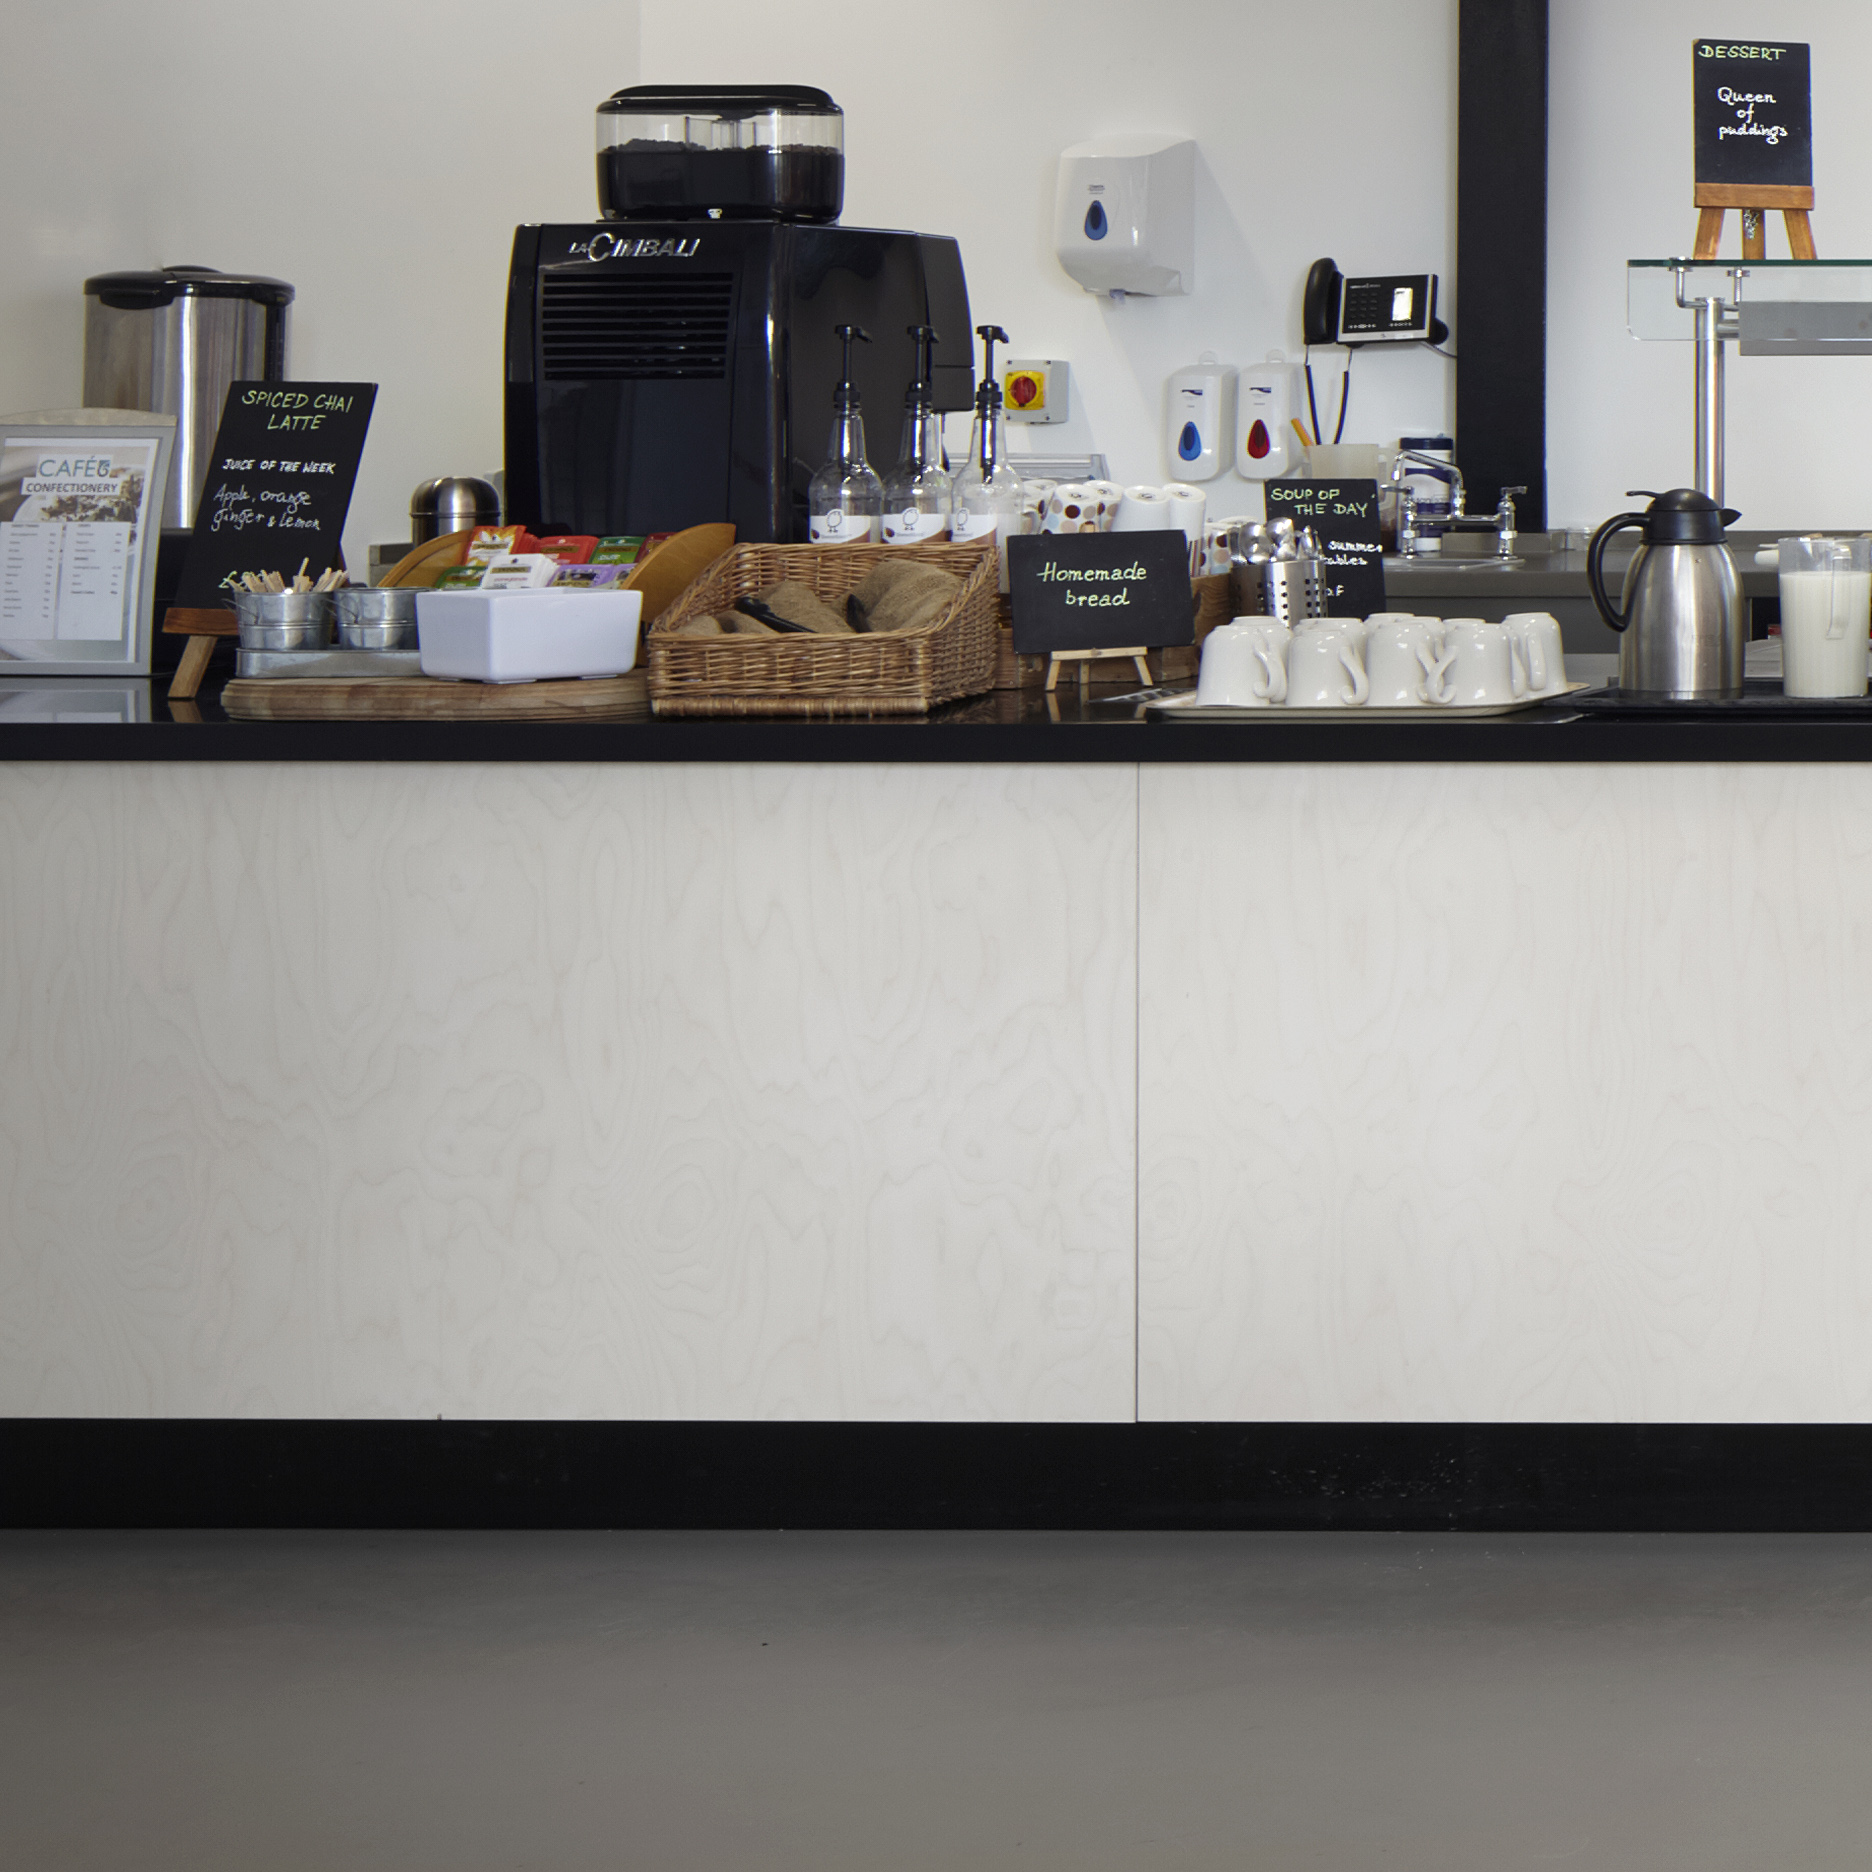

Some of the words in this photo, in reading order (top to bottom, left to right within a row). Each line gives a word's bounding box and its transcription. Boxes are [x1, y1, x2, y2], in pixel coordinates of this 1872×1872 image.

[1698, 45, 1787, 61] DESSERT
[1717, 86, 1777, 106] Queen
[1736, 103, 1755, 124] of
[1718, 122, 1789, 145] puddings
[568, 241, 589, 254] LA
[241, 390, 309, 409] SPICED
[313, 394, 354, 413] CHAI
[266, 414, 327, 431] LATTE
[222, 458, 256, 471] JUICE
[259, 460, 277, 471] OF
[278, 460, 302, 472] THE
[302, 460, 337, 475] WEEK
[26, 482, 119, 494] CONFECTIONERY
[1270, 487, 1313, 501] SOUP
[1317, 488, 1340, 501] OF
[1293, 502, 1327, 516] THE
[1332, 502, 1368, 518] DAY
[1036, 561, 1147, 582] Homemade
[1065, 587, 1131, 607] bread
